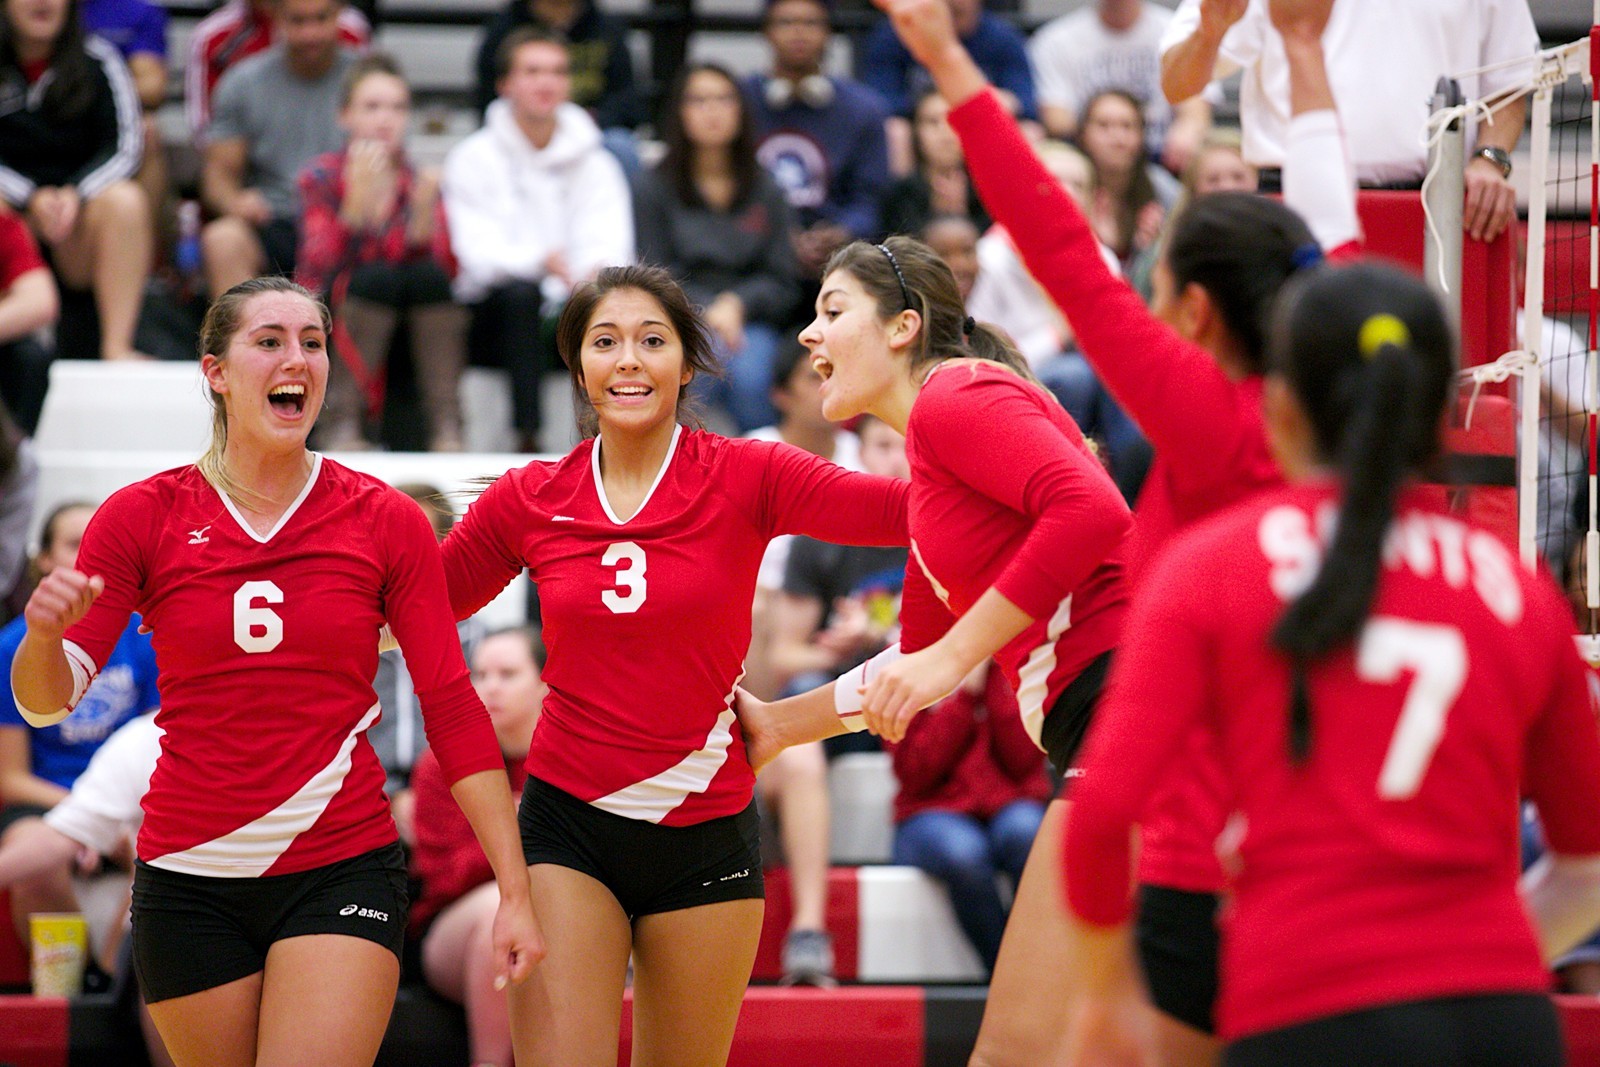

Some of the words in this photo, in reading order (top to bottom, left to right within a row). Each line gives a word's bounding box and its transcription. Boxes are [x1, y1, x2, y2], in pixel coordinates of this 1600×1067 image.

[601, 541, 647, 614] 3
[1258, 500, 1523, 627] SNTS
[233, 580, 284, 653] 6
[1356, 616, 1469, 800] 7
[358, 907, 389, 922] asics
